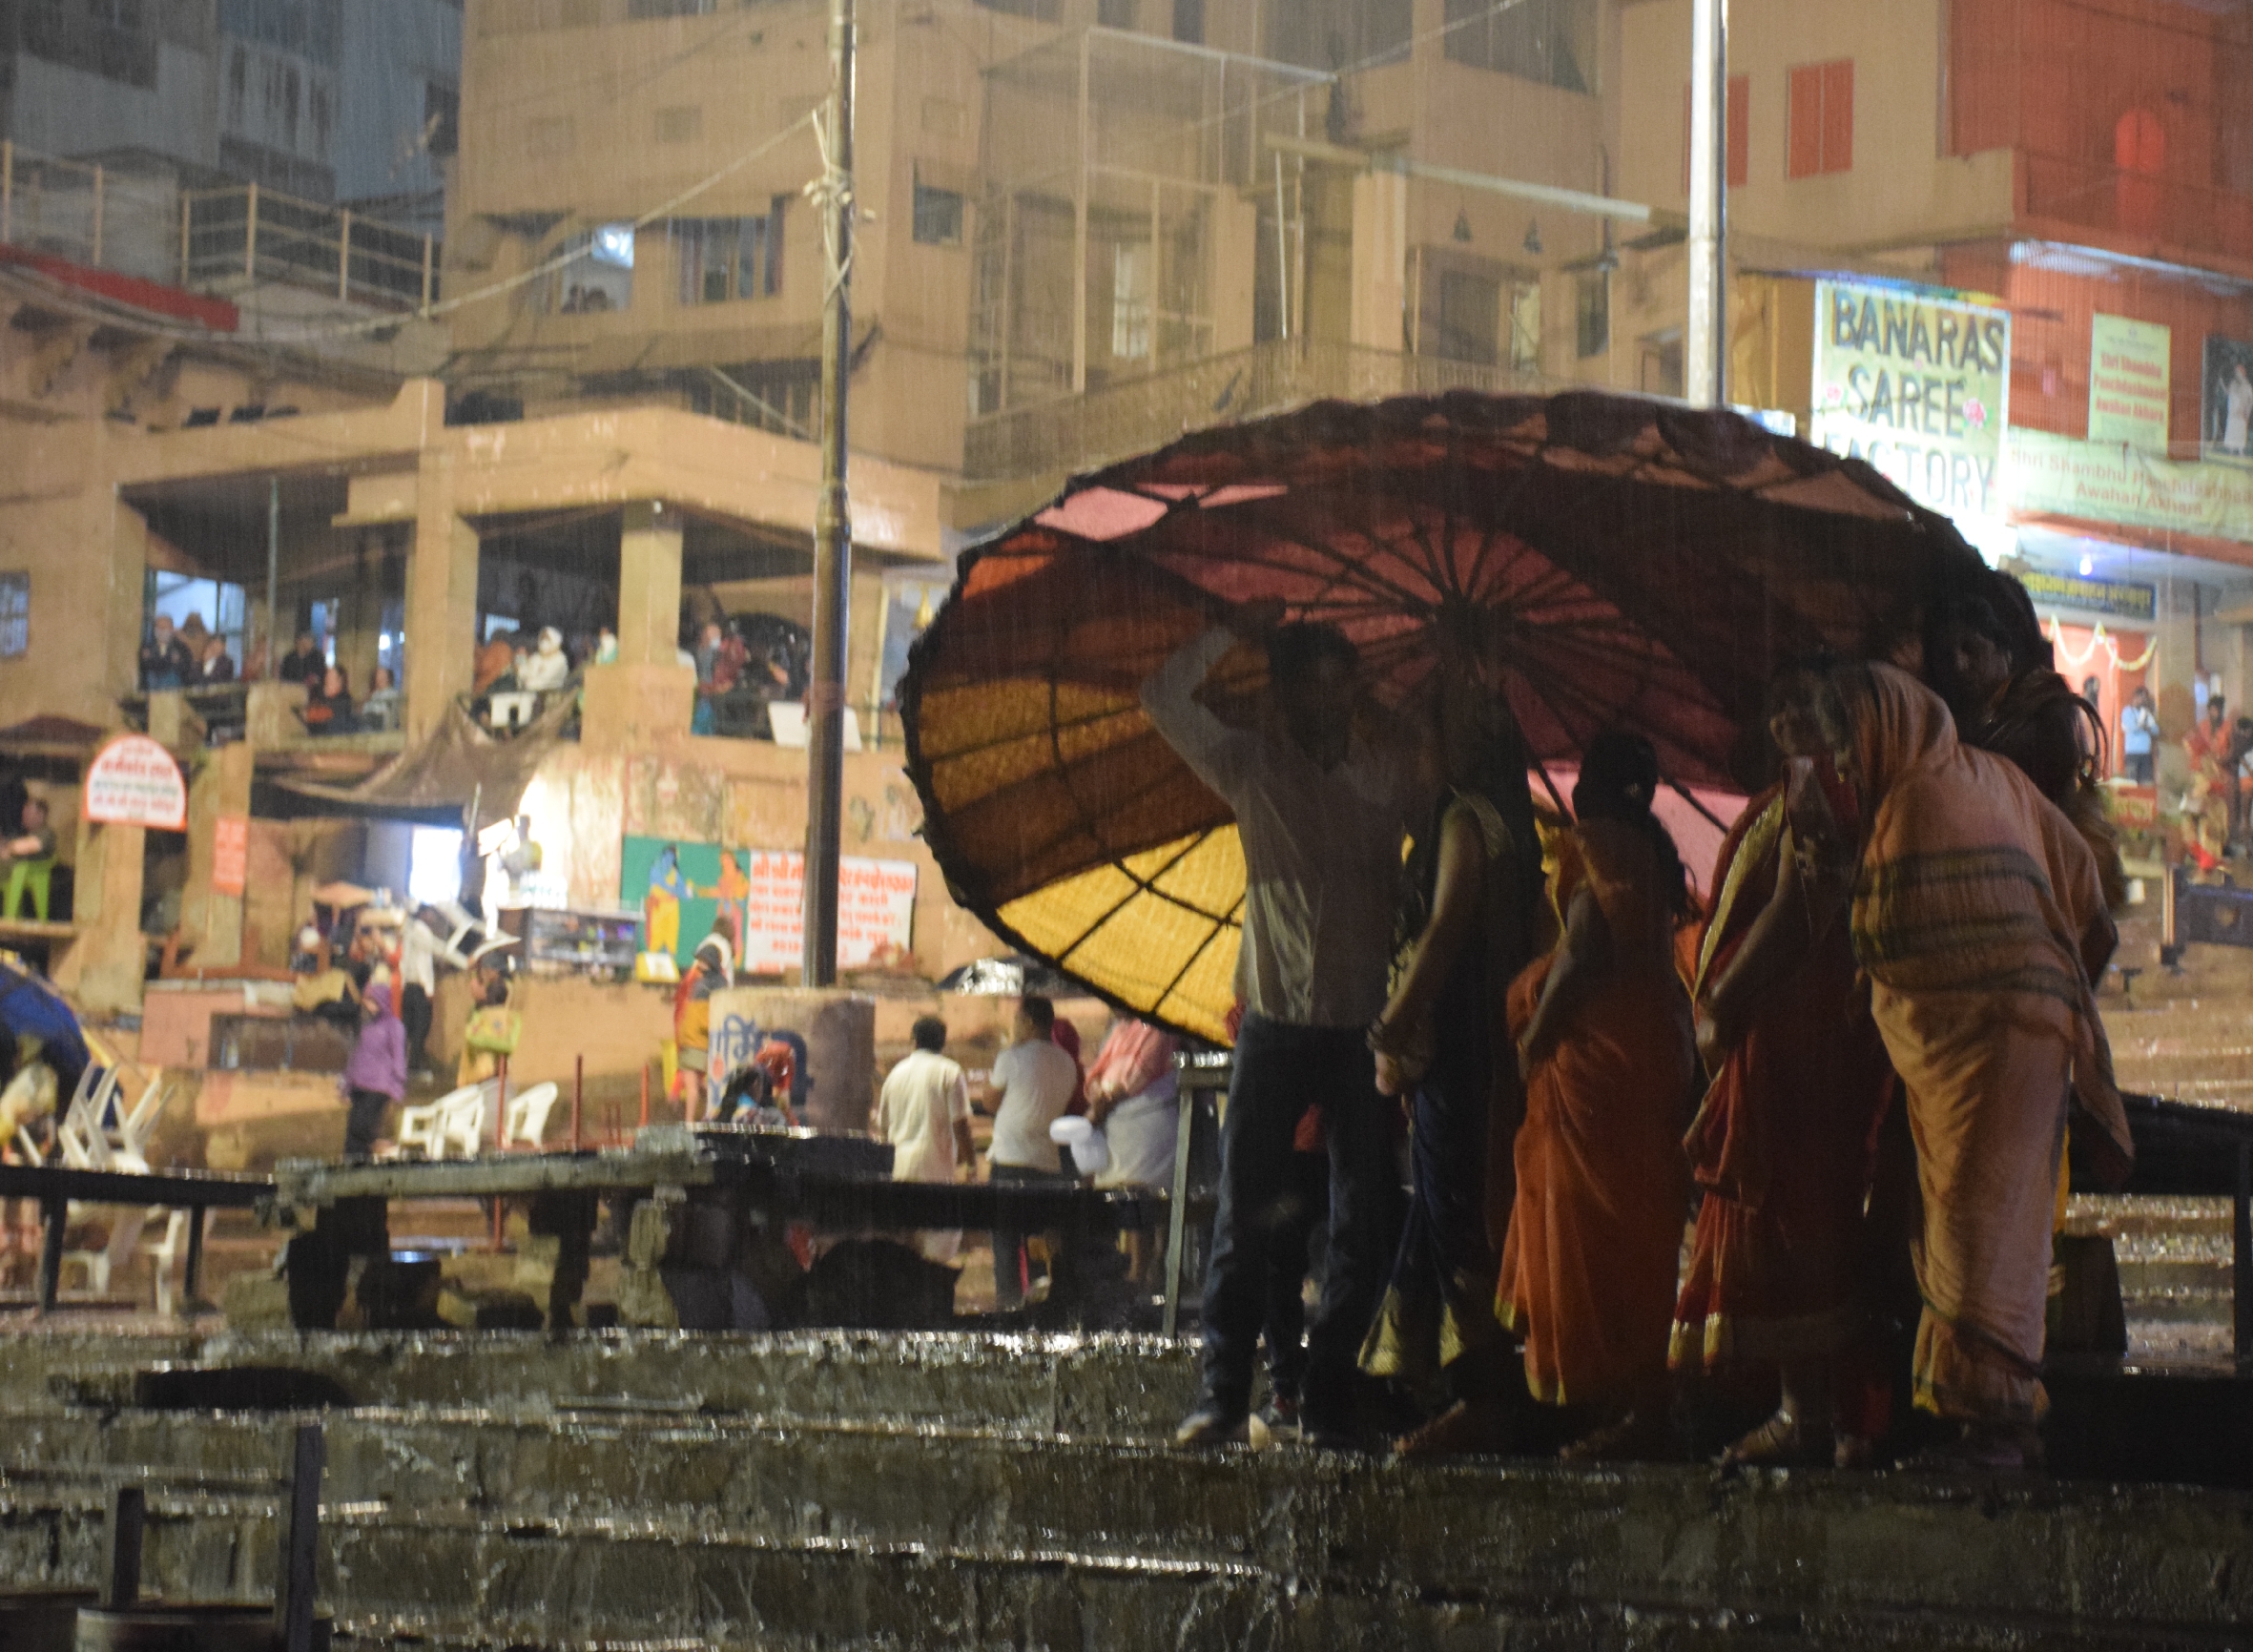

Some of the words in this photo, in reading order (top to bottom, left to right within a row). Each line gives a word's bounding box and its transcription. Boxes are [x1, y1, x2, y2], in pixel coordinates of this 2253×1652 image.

[1831, 289, 2005, 374] BANARAS
[1848, 363, 1965, 438] SAREE
[2012, 448, 2043, 468] Shri
[2050, 454, 2127, 484] Shambhu
[2077, 481, 2139, 507] Awahan
[2146, 494, 2202, 516] Akhara
